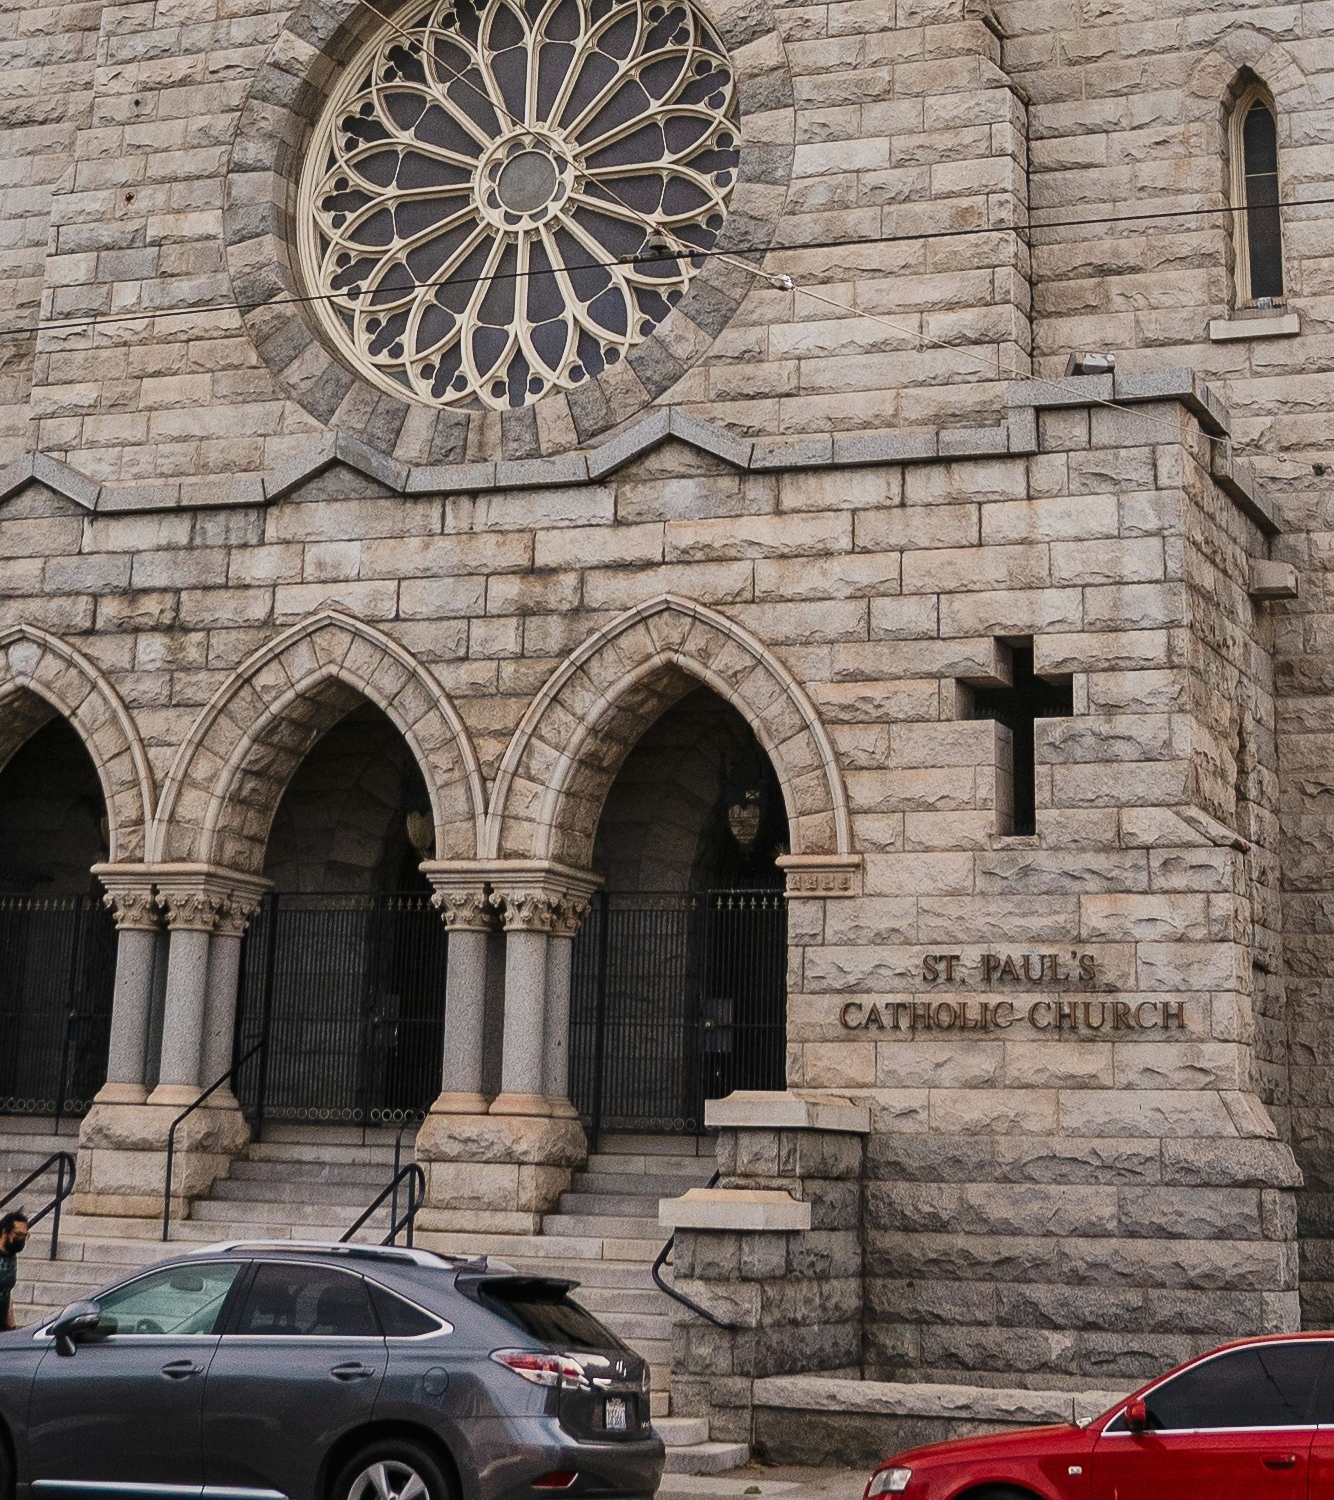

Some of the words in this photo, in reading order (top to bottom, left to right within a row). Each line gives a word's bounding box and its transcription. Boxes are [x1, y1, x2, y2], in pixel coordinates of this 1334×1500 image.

[981, 950, 1097, 984] PAUL'S
[838, 1001, 1015, 1031] CATHOLIC
[1027, 1001, 1187, 1031] CHURCH
